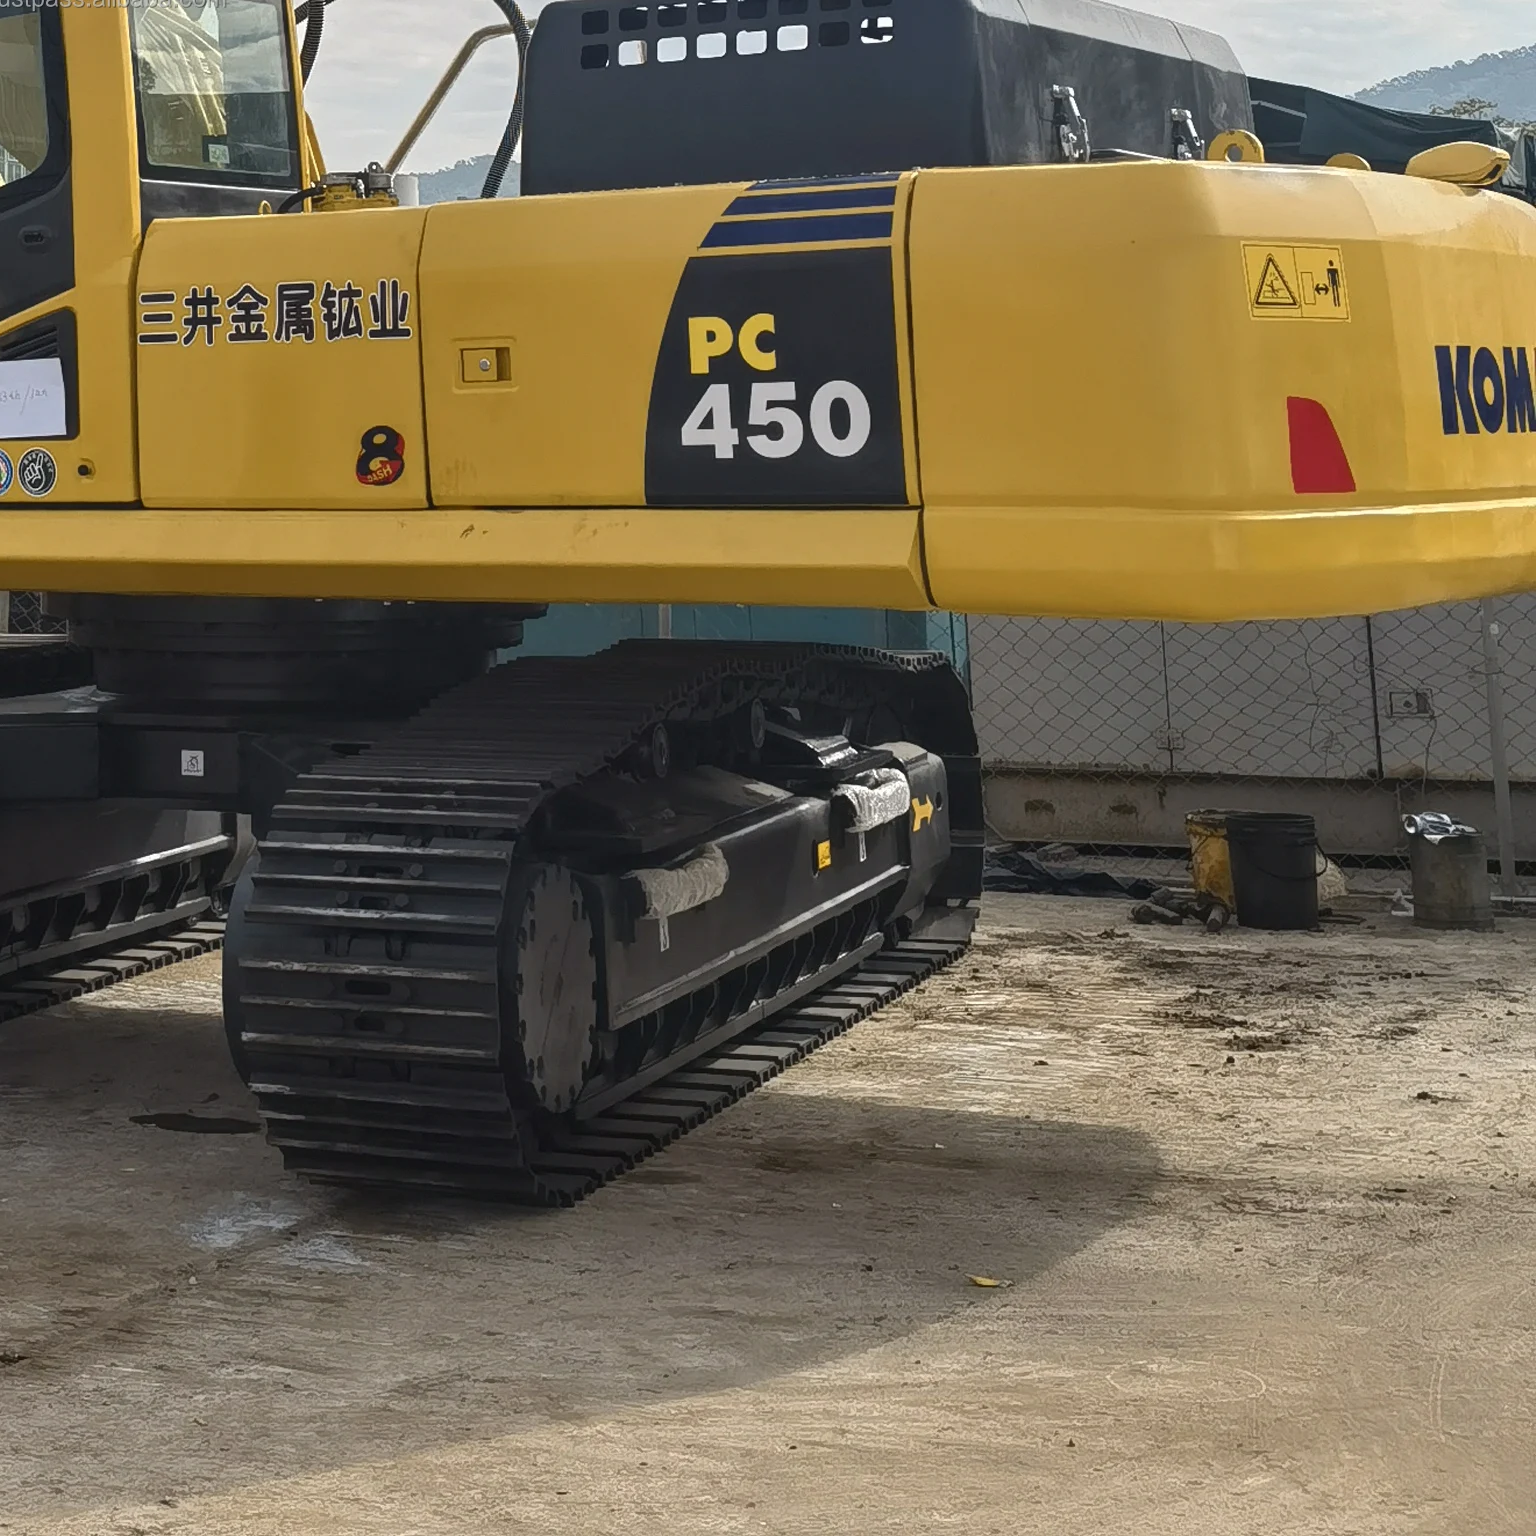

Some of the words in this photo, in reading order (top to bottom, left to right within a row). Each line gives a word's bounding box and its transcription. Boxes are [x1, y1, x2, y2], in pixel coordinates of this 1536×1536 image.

[688, 313, 776, 374] PC
[681, 380, 871, 459] 450
[1434, 345, 1536, 435] KOM
[356, 425, 405, 486] 8
